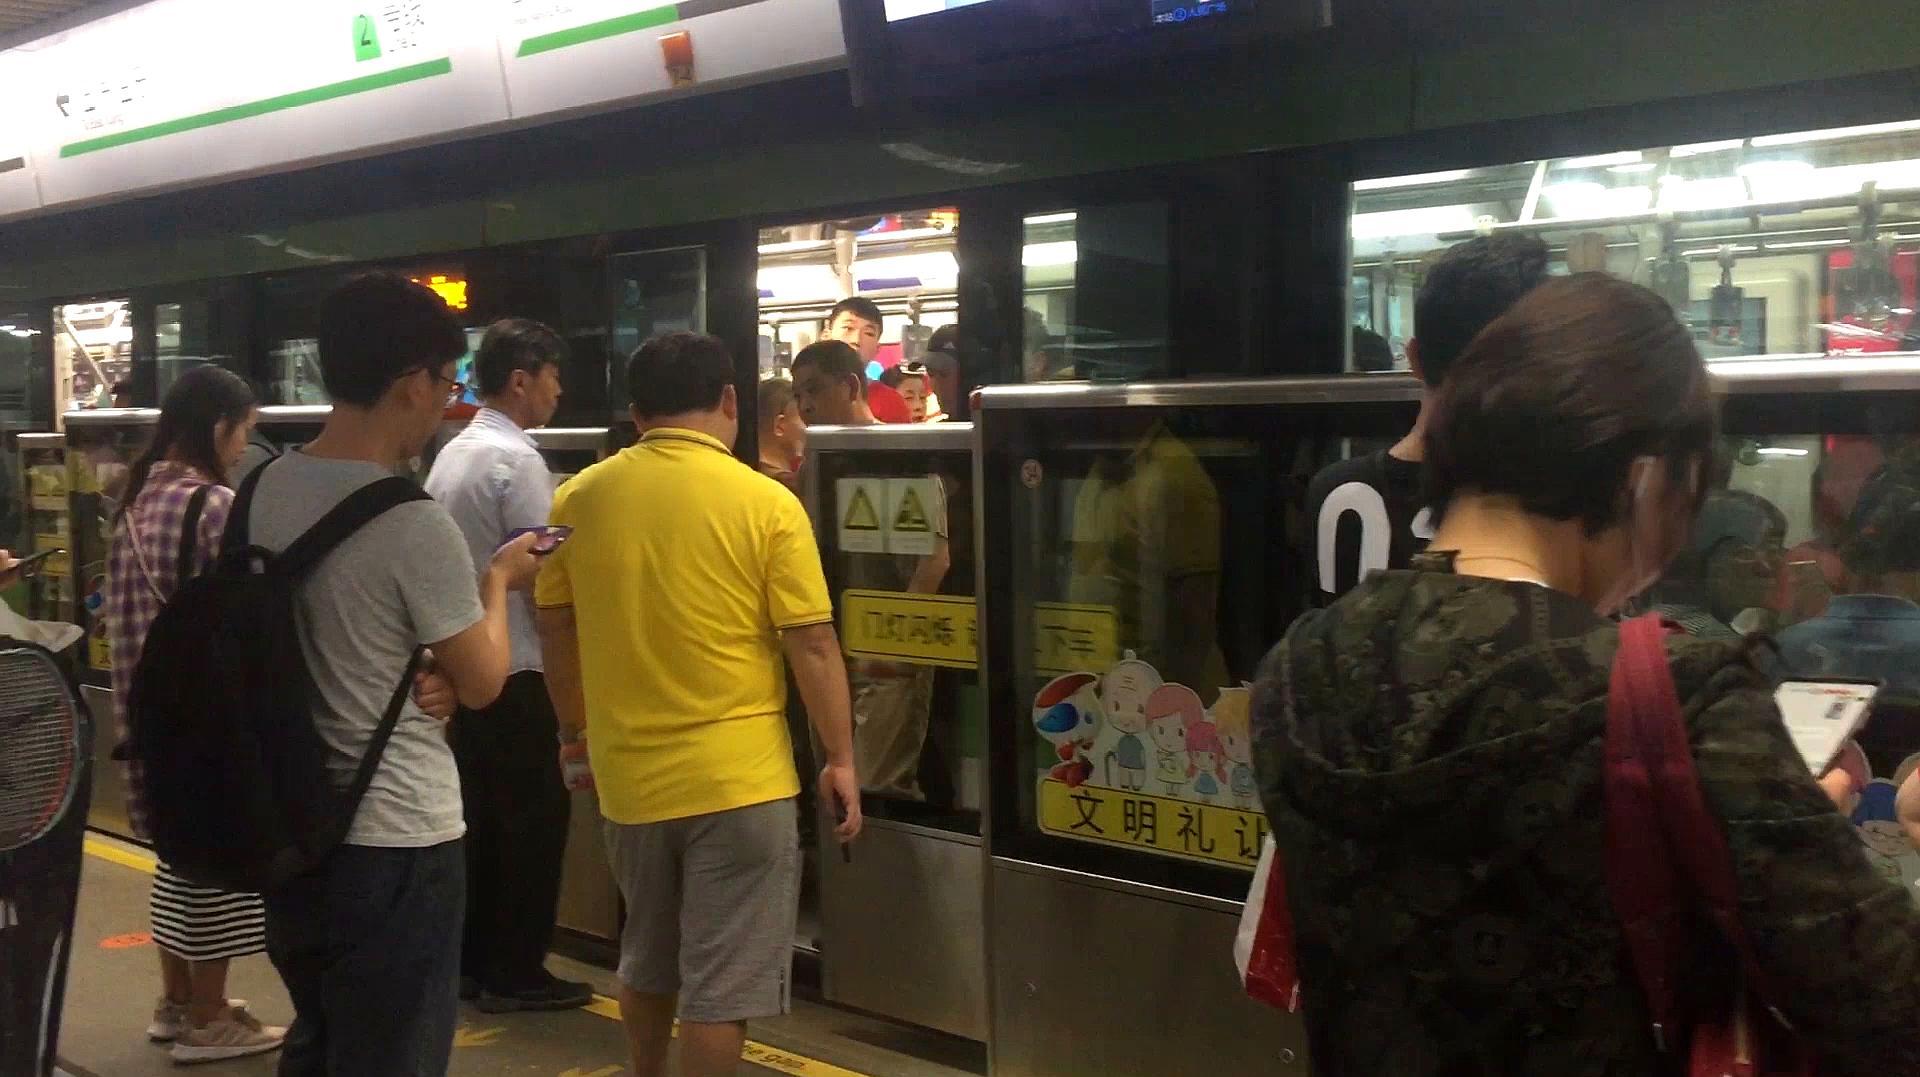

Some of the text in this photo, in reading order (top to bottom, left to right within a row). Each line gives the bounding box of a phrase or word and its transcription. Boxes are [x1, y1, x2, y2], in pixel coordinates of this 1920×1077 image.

[360, 14, 371, 46] 2
[1070, 790, 1267, 860] 文明礼让
